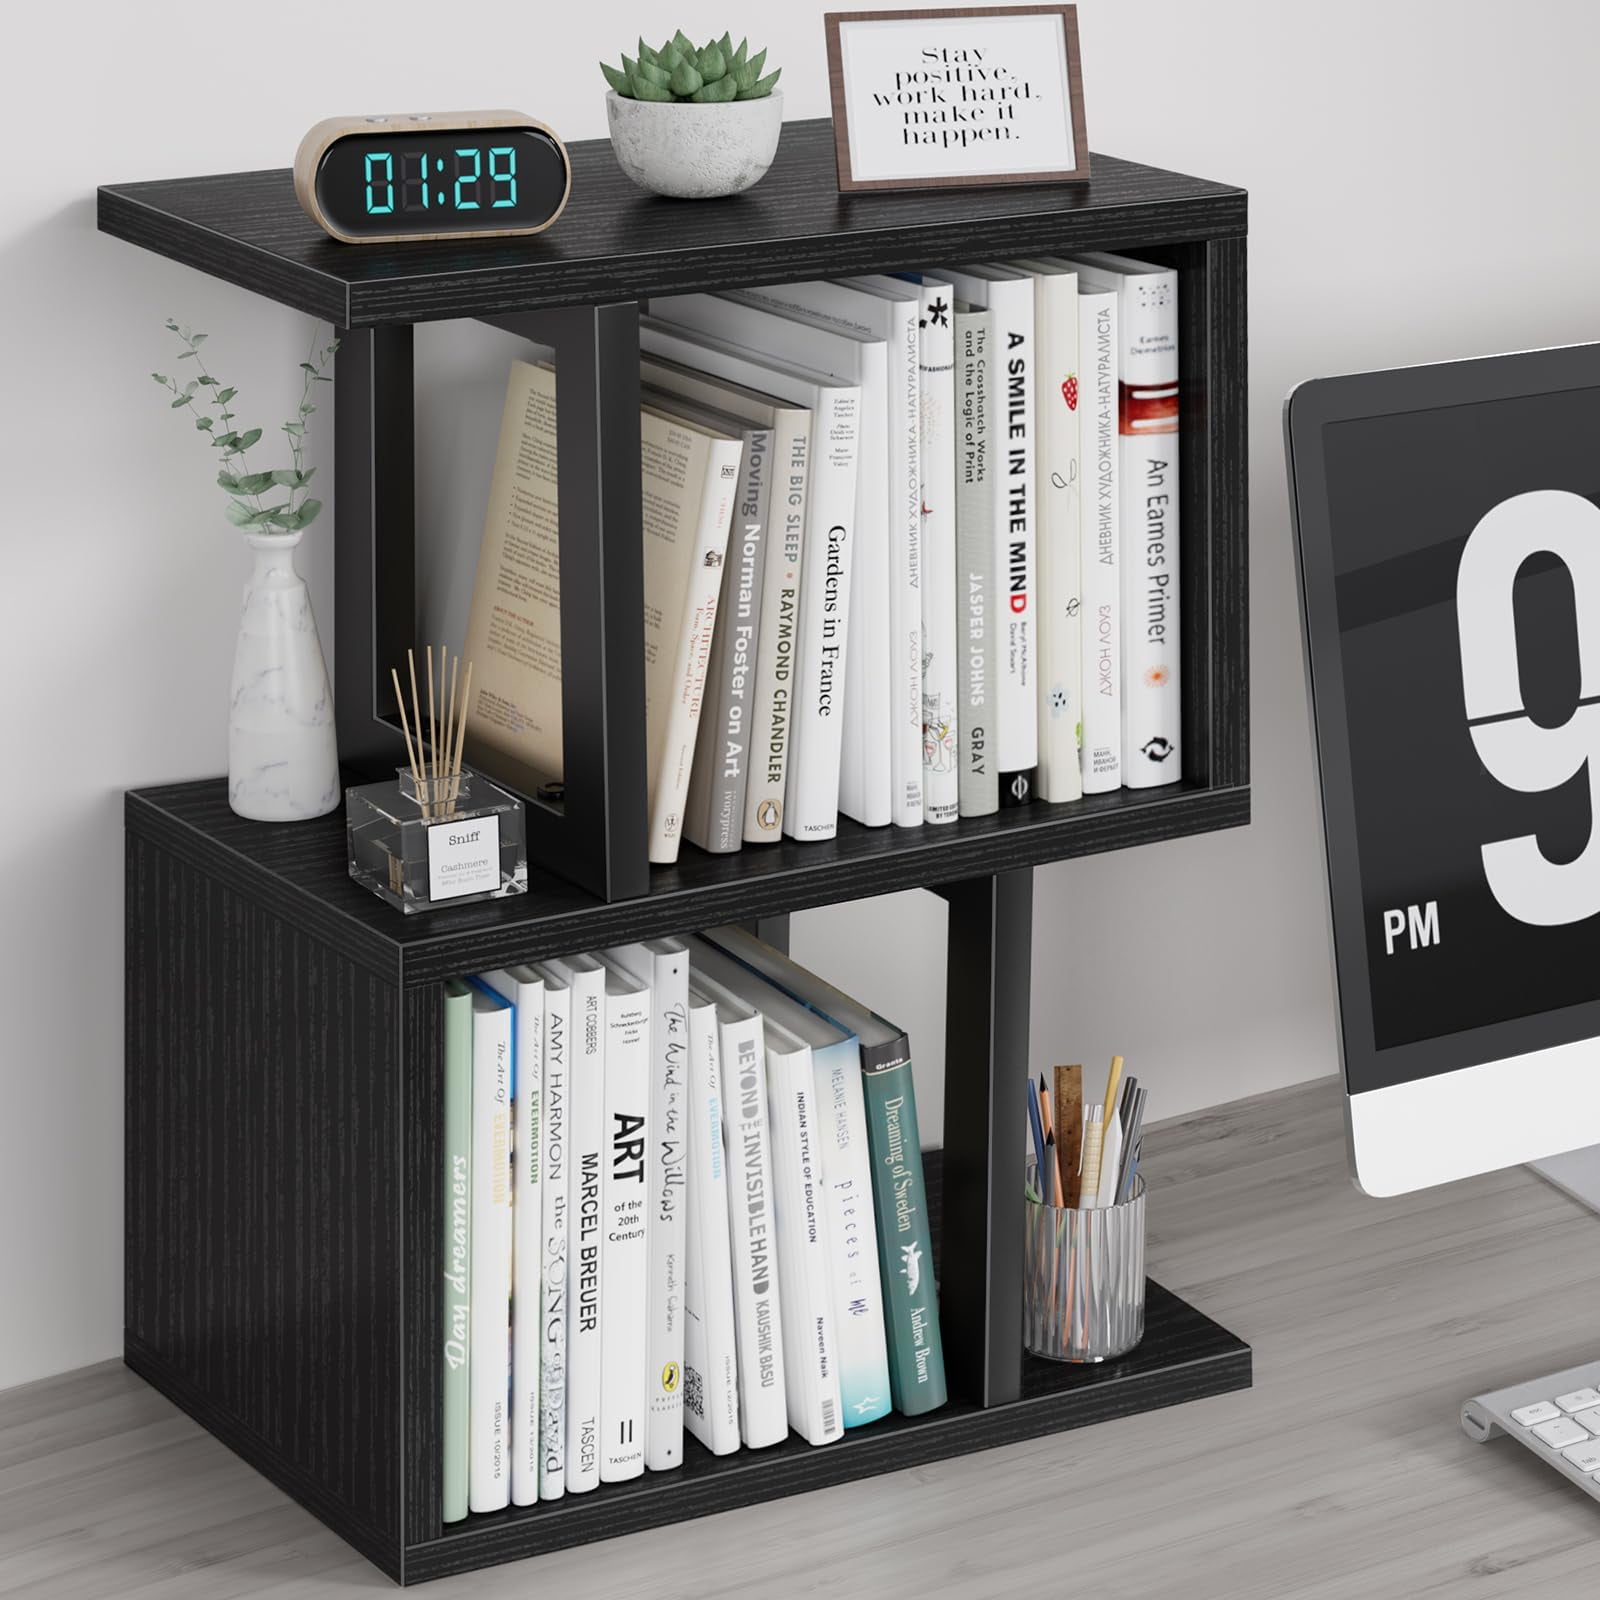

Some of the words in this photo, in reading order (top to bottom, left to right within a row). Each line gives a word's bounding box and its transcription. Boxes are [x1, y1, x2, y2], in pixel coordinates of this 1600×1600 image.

[922, 47, 987, 64] Stay
[873, 87, 947, 106] work
[962, 82, 1042, 101] hard,
[896, 63, 1018, 91] positive,
[904, 105, 985, 124] make
[997, 102, 1014, 120] it
[903, 127, 1020, 149] happen.
[365, 146, 517, 215] 01:29
[965, 330, 975, 358] and
[976, 328, 986, 354] The
[1007, 331, 1025, 350] A
[965, 363, 974, 386] the
[963, 391, 975, 429] Logic
[976, 359, 987, 435] Crosshatch
[1008, 359, 1025, 440] SMILE
[791, 436, 807, 468] THE
[965, 432, 975, 446] of
[742, 433, 768, 517] Moving
[965, 452, 975, 484] Print
[976, 439, 986, 483] Works
[1008, 448, 1026, 476] IN
[1147, 459, 1169, 488] An
[788, 475, 803, 507] BIG
[1009, 484, 1026, 533] THE
[784, 513, 802, 564] SLEEP
[1099, 503, 1114, 565] ДНЕВНИК
[1147, 494, 1169, 567] Eames
[737, 524, 761, 618] Norman
[824, 525, 847, 613] Gardens
[1009, 541, 1027, 614] MIND
[969, 572, 985, 640] JASPER
[1099, 604, 1112, 644] ЛОУЗ
[1147, 573, 1171, 646] Primer
[775, 588, 796, 682] RAYMOND
[822, 619, 842, 639] in
[731, 625, 752, 699] Foster
[818, 645, 840, 717] France
[970, 646, 985, 707] JOHNS
[1099, 648, 1113, 697] ДЖОН
[728, 706, 744, 735] on
[1456, 489, 1600, 926] 9
[766, 689, 788, 784] CHANDLER
[971, 727, 985, 775] GRAY
[724, 741, 743, 778] Art
[448, 830, 481, 846] Sniff
[719, 790, 732, 850] ivorypress
[441, 859, 489, 873] Cashmere
[1383, 900, 1442, 955] PM
[586, 995, 598, 1013] ART
[663, 1002, 687, 1034] The
[497, 1041, 506, 1062] The
[549, 1012, 563, 1065] AMY
[664, 1042, 687, 1090] Wind
[738, 1039, 759, 1119] BEYOND
[875, 1057, 904, 1071] Granta
[669, 1092, 681, 1105] in
[831, 1069, 848, 1110] MELANIE
[549, 1073, 563, 1181] HARMON
[665, 1107, 681, 1133] the
[796, 1092, 807, 1129] INDIAN
[884, 1095, 907, 1165] Dreaming
[530, 1090, 540, 1185] EVERMOTION
[612, 1112, 645, 1184] ART
[799, 1132, 810, 1164] STYLE
[836, 1112, 849, 1151] HANSEN
[659, 1140, 686, 1223] Willows
[743, 1132, 767, 1237] INVISIBLE
[803, 1166, 812, 1179] OF
[893, 1165, 912, 1179] of
[554, 1196, 566, 1230] the
[580, 1152, 599, 1241] MARCEL
[614, 1201, 625, 1213] of
[627, 1199, 643, 1211] the
[804, 1184, 817, 1243] EDUCATION
[894, 1178, 916, 1233] Sweden
[608, 1228, 645, 1243] Century
[617, 1214, 640, 1228] 20th
[750, 1238, 770, 1295] HAND
[547, 1237, 566, 1344] SONG
[580, 1245, 598, 1333] BREUER
[444, 1301, 470, 1369] Day
[755, 1299, 772, 1354] KAUSHIK
[816, 1317, 826, 1354] Naveen
[909, 1307, 930, 1347] Andrew
[758, 1354, 774, 1388] BASU
[820, 1356, 828, 1378] Naik
[914, 1346, 931, 1384] Brown
[493, 1401, 502, 1435] ISSUE
[493, 1439, 502, 1479] 10/2015
[609, 1452, 642, 1464] TASCHEN
